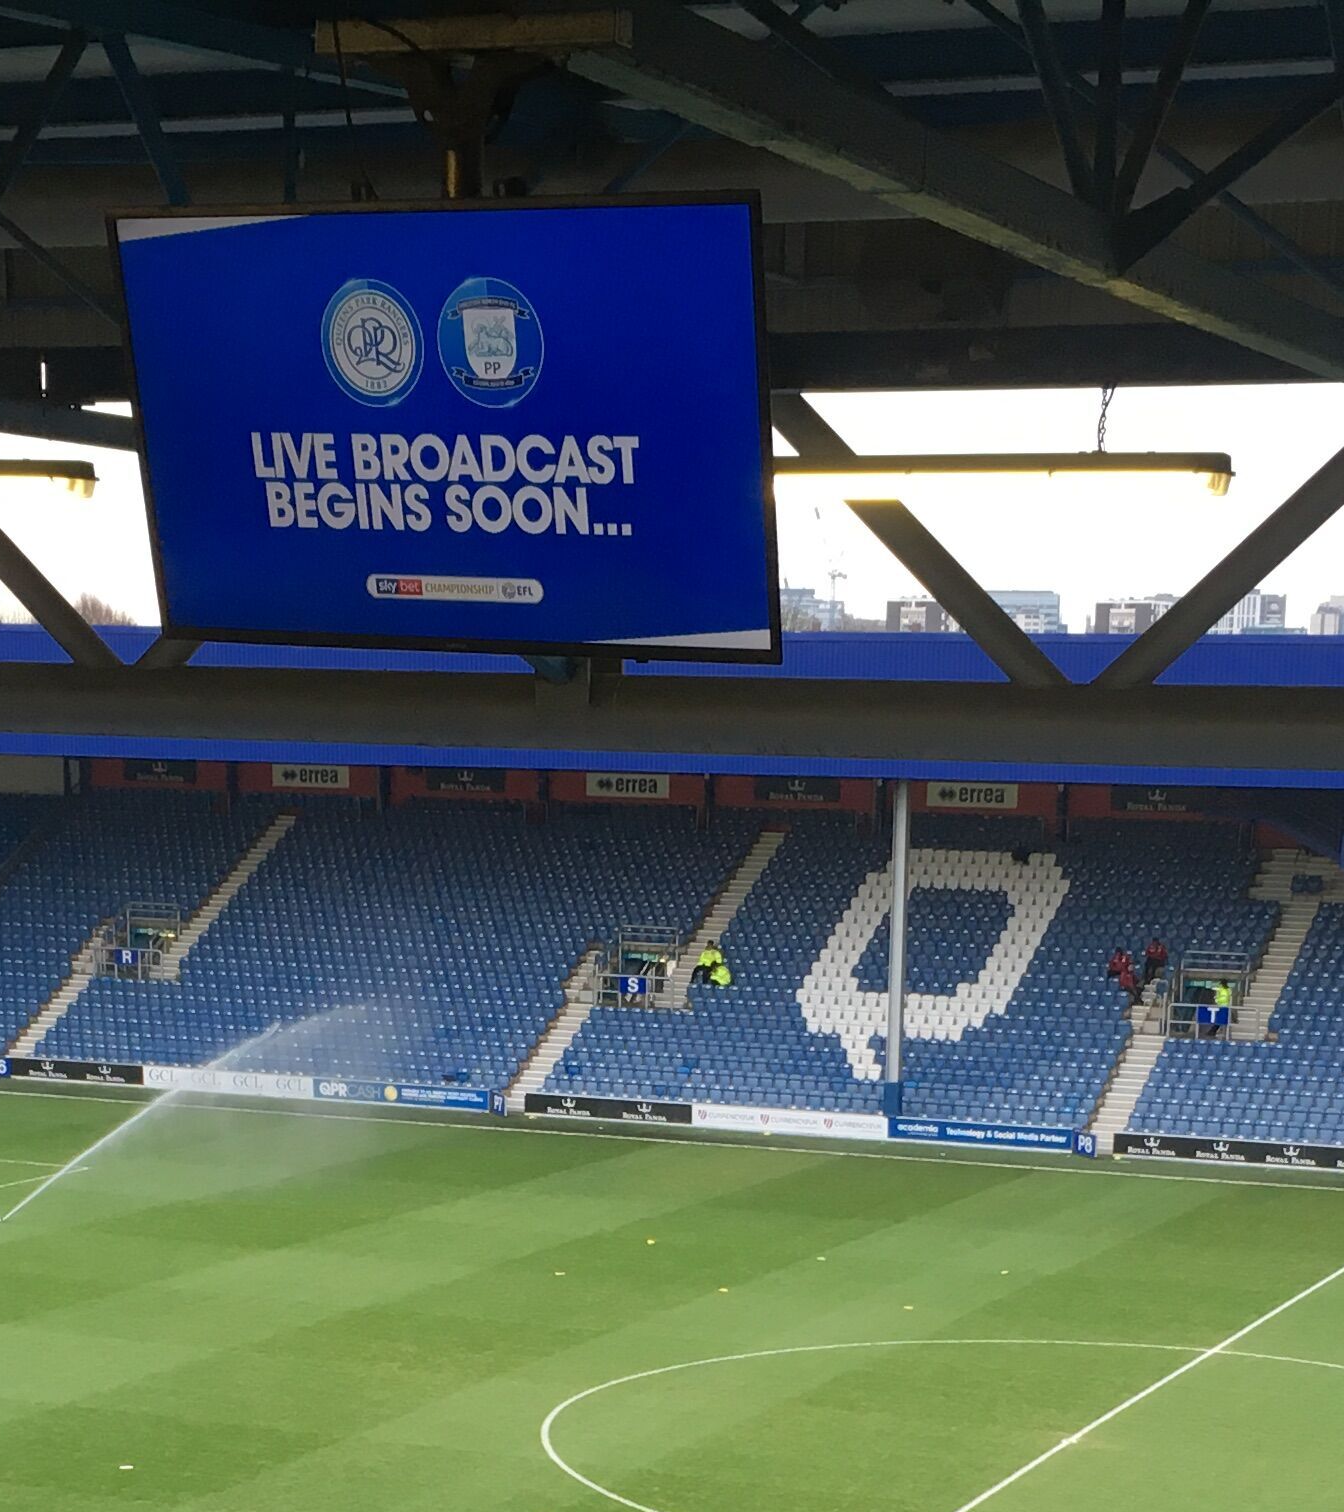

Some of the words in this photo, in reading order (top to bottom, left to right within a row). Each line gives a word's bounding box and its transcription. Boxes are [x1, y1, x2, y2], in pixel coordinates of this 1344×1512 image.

[484, 362, 501, 374] PP
[251, 432, 338, 480] LIVE
[351, 432, 639, 484] BROADCAST
[265, 481, 432, 533] BEGINS
[445, 484, 633, 536] SOON...
[377, 579, 397, 595] sky
[399, 579, 422, 594] bet
[425, 583, 495, 595] CHAMPIONSHIP
[516, 585, 533, 597] EFL
[299, 767, 339, 784] errea
[615, 776, 657, 794] errea
[958, 786, 1005, 804] errea
[122, 950, 132, 964] R
[627, 977, 639, 993] S
[1207, 1007, 1220, 1024] T
[149, 1068, 178, 1083] GCL
[191, 1071, 222, 1086] GCL
[232, 1074, 262, 1089] GCL
[276, 1077, 306, 1092] GCL
[494, 1095, 502, 1111] P7
[946, 1127, 985, 1139] Technology
[994, 1130, 1016, 1140] Social
[1017, 1132, 1038, 1141] Media
[1040, 1133, 1067, 1143] Partner
[1078, 1135, 1092, 1154] P8
